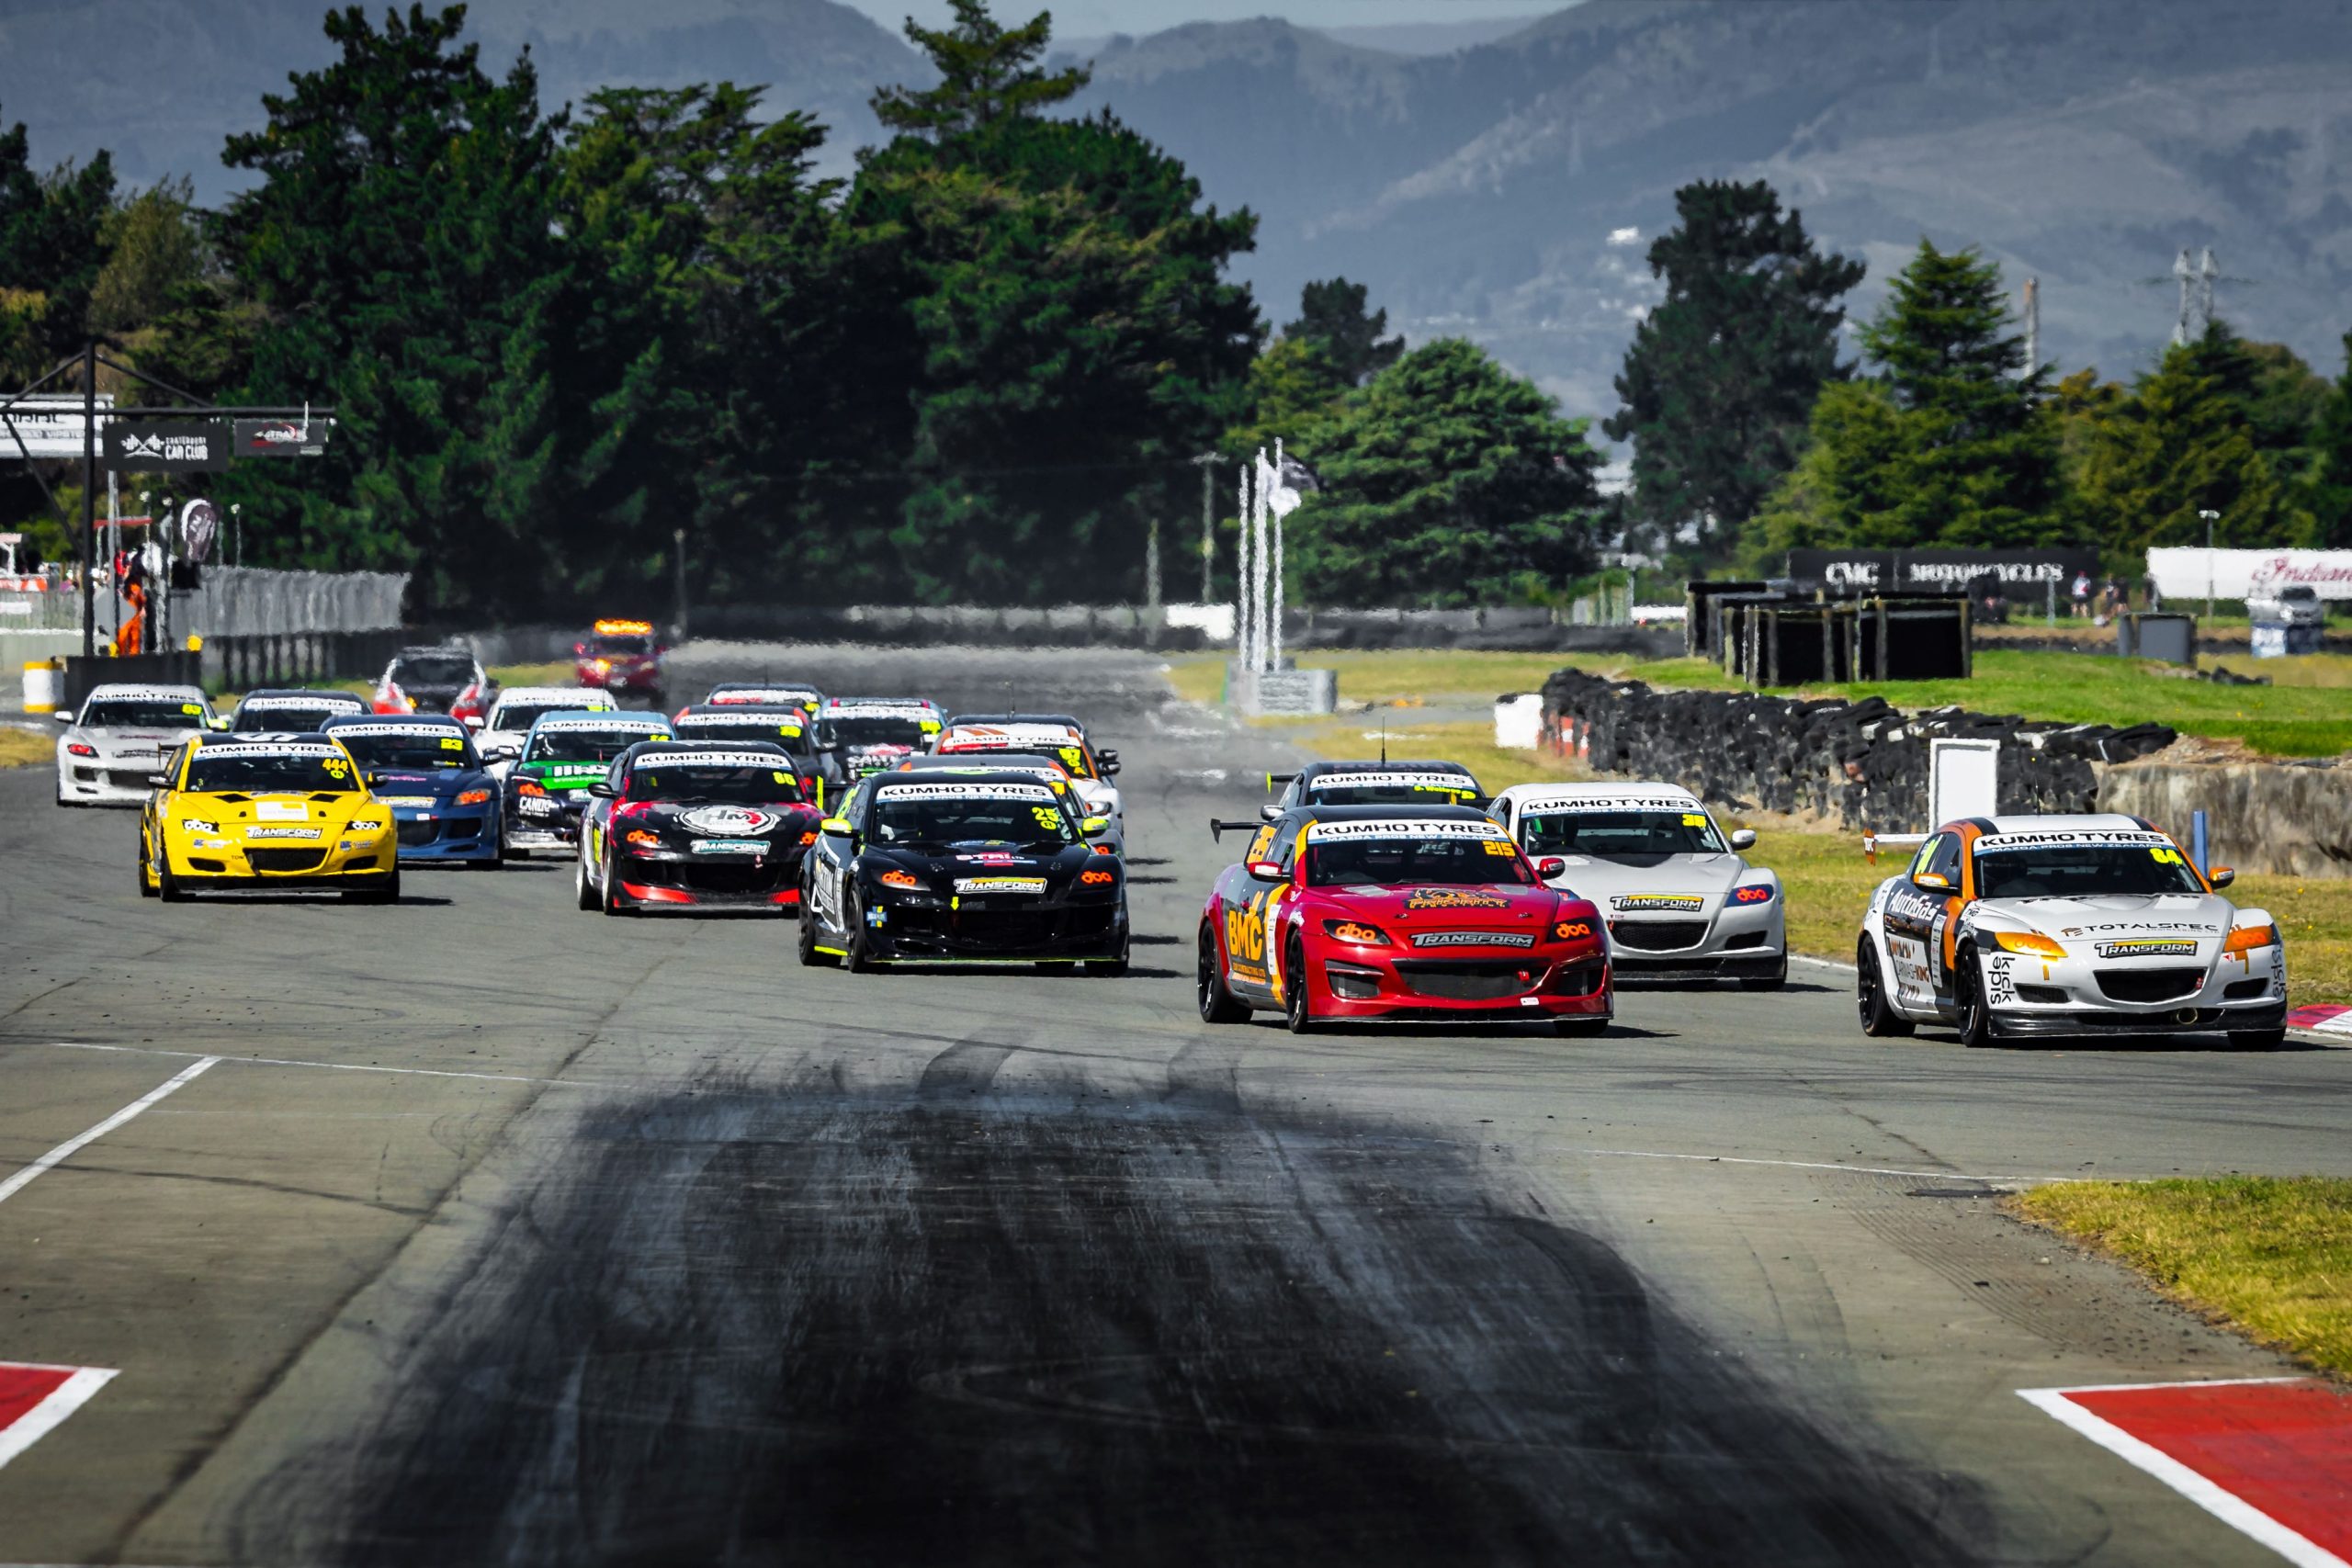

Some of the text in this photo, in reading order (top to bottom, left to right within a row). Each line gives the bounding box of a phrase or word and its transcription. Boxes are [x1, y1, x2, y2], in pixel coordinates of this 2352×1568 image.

[164, 445, 209, 460] CAR CLUB
[149, 693, 197, 701] TYRES
[309, 699, 357, 708] TYRES
[331, 725, 457, 734] KUMHO TYRES
[609, 722, 663, 730] TYRES
[199, 745, 339, 754] KUMHO TYRES
[322, 758, 348, 772] 444
[641, 753, 783, 764] KUMHO TYRES
[1317, 774, 1466, 784] KUMHO TYRES
[883, 785, 1046, 796] KUMHO TYRES
[1529, 799, 1694, 810] KUMHO TYRES
[1032, 807, 1058, 822] 25
[246, 826, 321, 839] TRANSFORM
[627, 829, 659, 844] dba
[1317, 824, 1498, 836] KUMHO TYRES
[1327, 834, 1373, 842] MAZDA
[1981, 833, 2165, 847] KUMHO TYRES
[691, 840, 770, 855] TRANSFORM
[1482, 840, 1516, 857] 215
[1991, 844, 2037, 853] MAZDA
[2149, 848, 2183, 864] 84
[882, 869, 916, 886] dba
[1080, 869, 1114, 885] dba
[954, 878, 1046, 894] TRANSFORM
[1736, 886, 1769, 902] dba
[1611, 896, 1702, 911] TRANSFORM
[1335, 922, 1376, 942] dba
[1555, 922, 1590, 939] dba
[2084, 922, 2221, 933] TOTALSPEC
[1228, 910, 1263, 962] BMC
[1411, 932, 1533, 947] TRANSFORM
[2095, 942, 2195, 957] TRANSFORM
